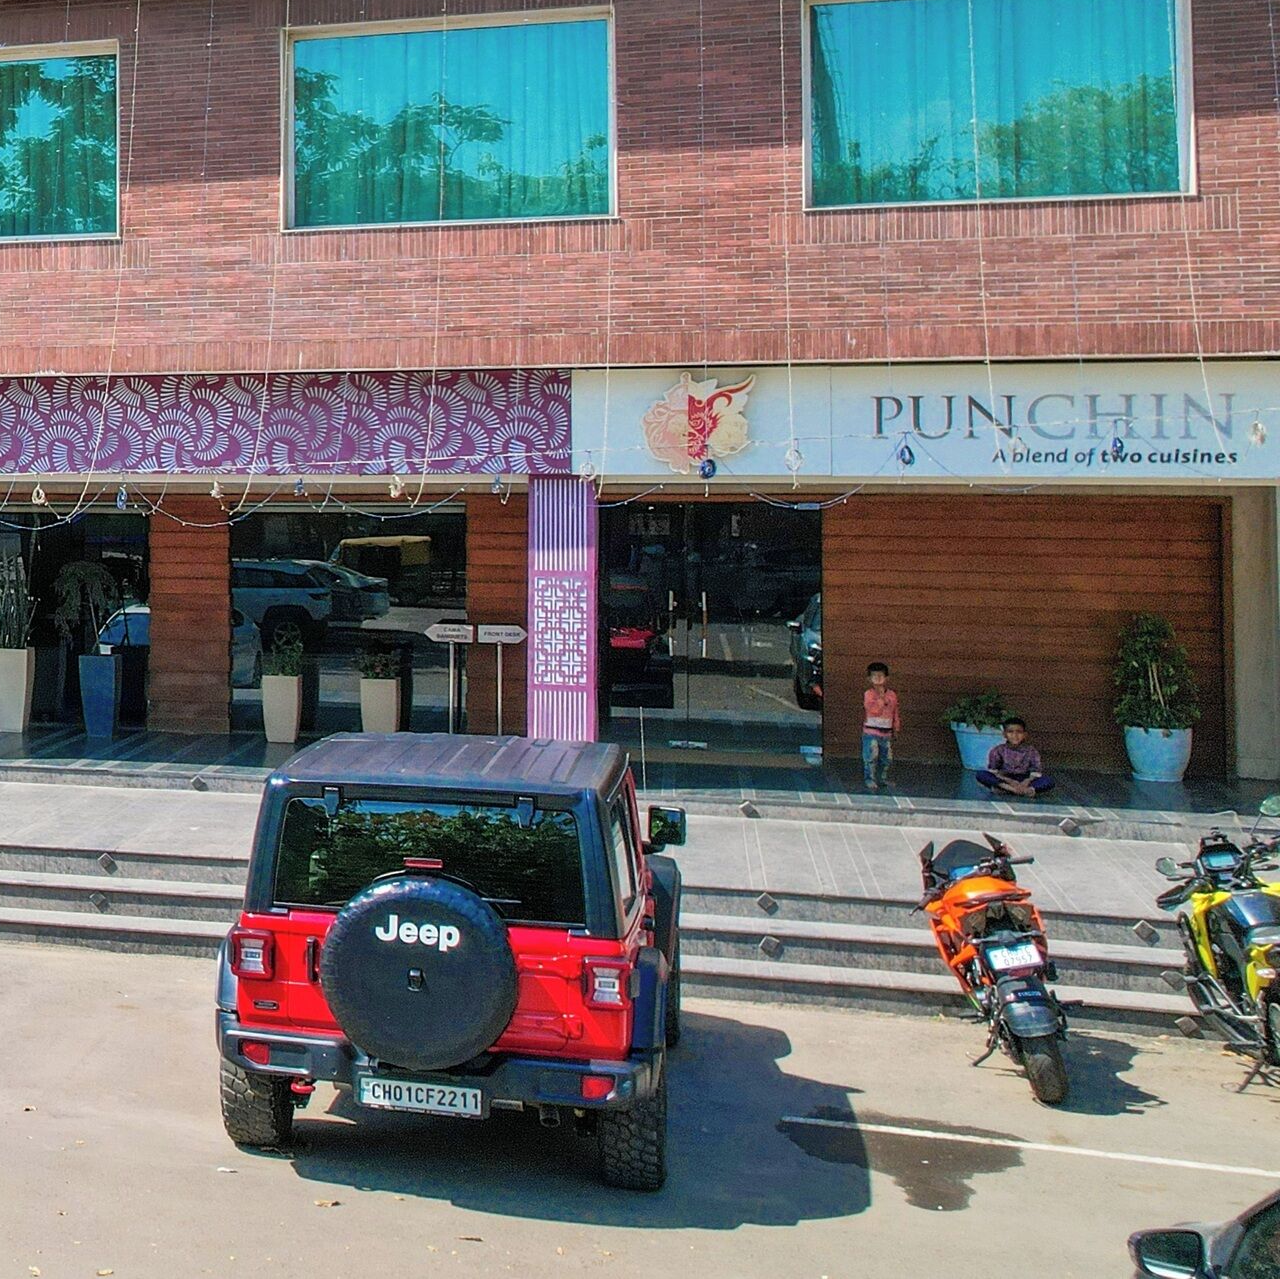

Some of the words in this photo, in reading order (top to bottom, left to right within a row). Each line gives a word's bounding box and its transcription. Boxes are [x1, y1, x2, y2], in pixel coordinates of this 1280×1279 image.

[871, 393, 1236, 441] PUNCHIN
[992, 449, 1006, 463] A
[1012, 448, 1068, 463] blend
[1074, 448, 1096, 467] of
[1100, 450, 1143, 464] two
[1148, 448, 1238, 464] cuisines
[375, 914, 461, 952] Jeep
[371, 1083, 480, 1111] CH01CF2211
